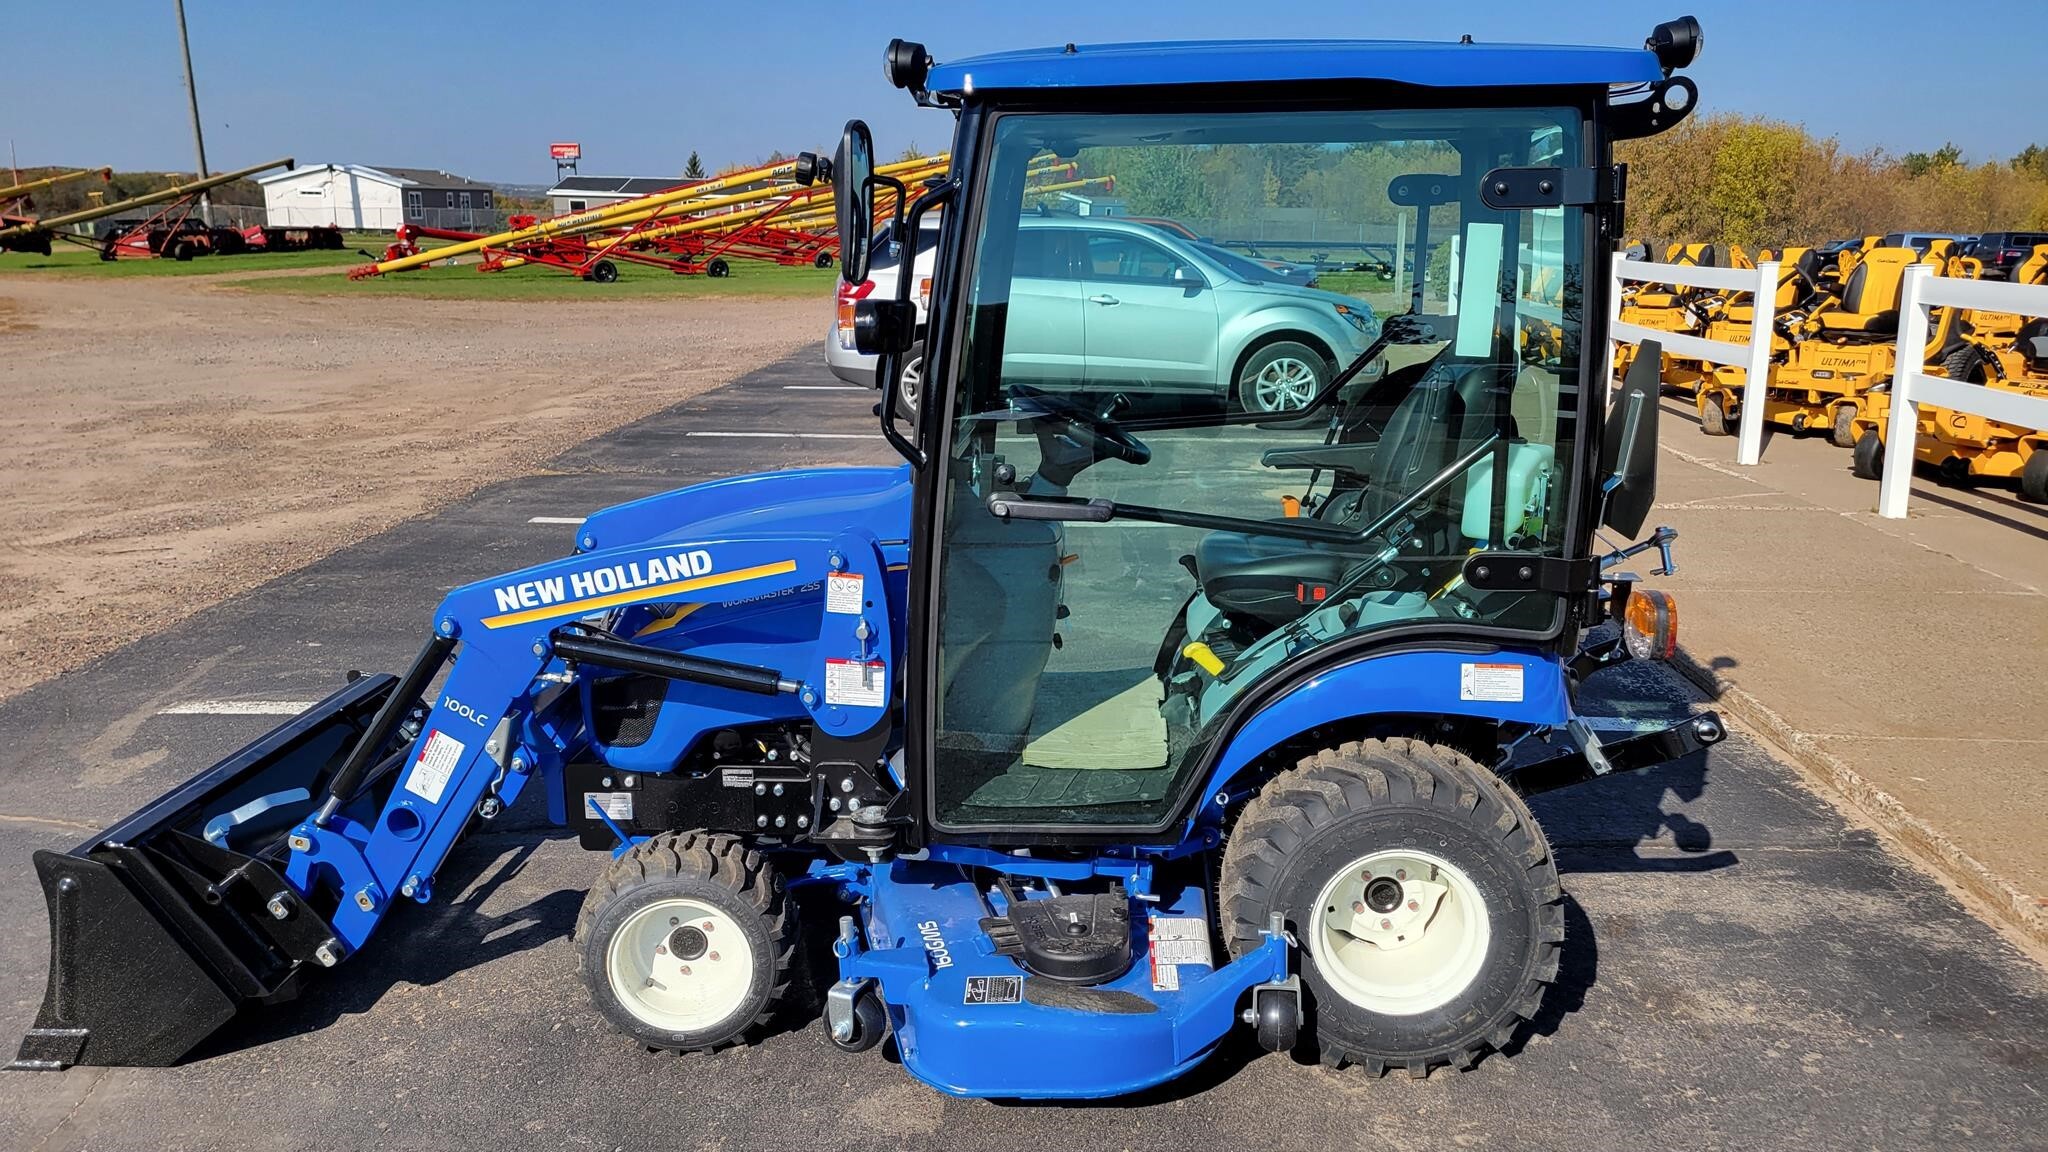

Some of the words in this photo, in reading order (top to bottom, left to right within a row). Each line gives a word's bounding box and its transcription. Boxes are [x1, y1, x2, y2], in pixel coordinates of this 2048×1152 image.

[771, 167, 786, 176] AGI
[1980, 313, 2003, 321] ULTIMA
[1639, 318, 1659, 326] ULTIMA
[1729, 335, 1751, 343] ULTIM
[1821, 357, 1856, 367] ULTIMA
[494, 576, 564, 612] NEW
[570, 549, 713, 598] HOLLAND
[444, 696, 489, 727] 100LC
[917, 920, 954, 970] 160GMS
